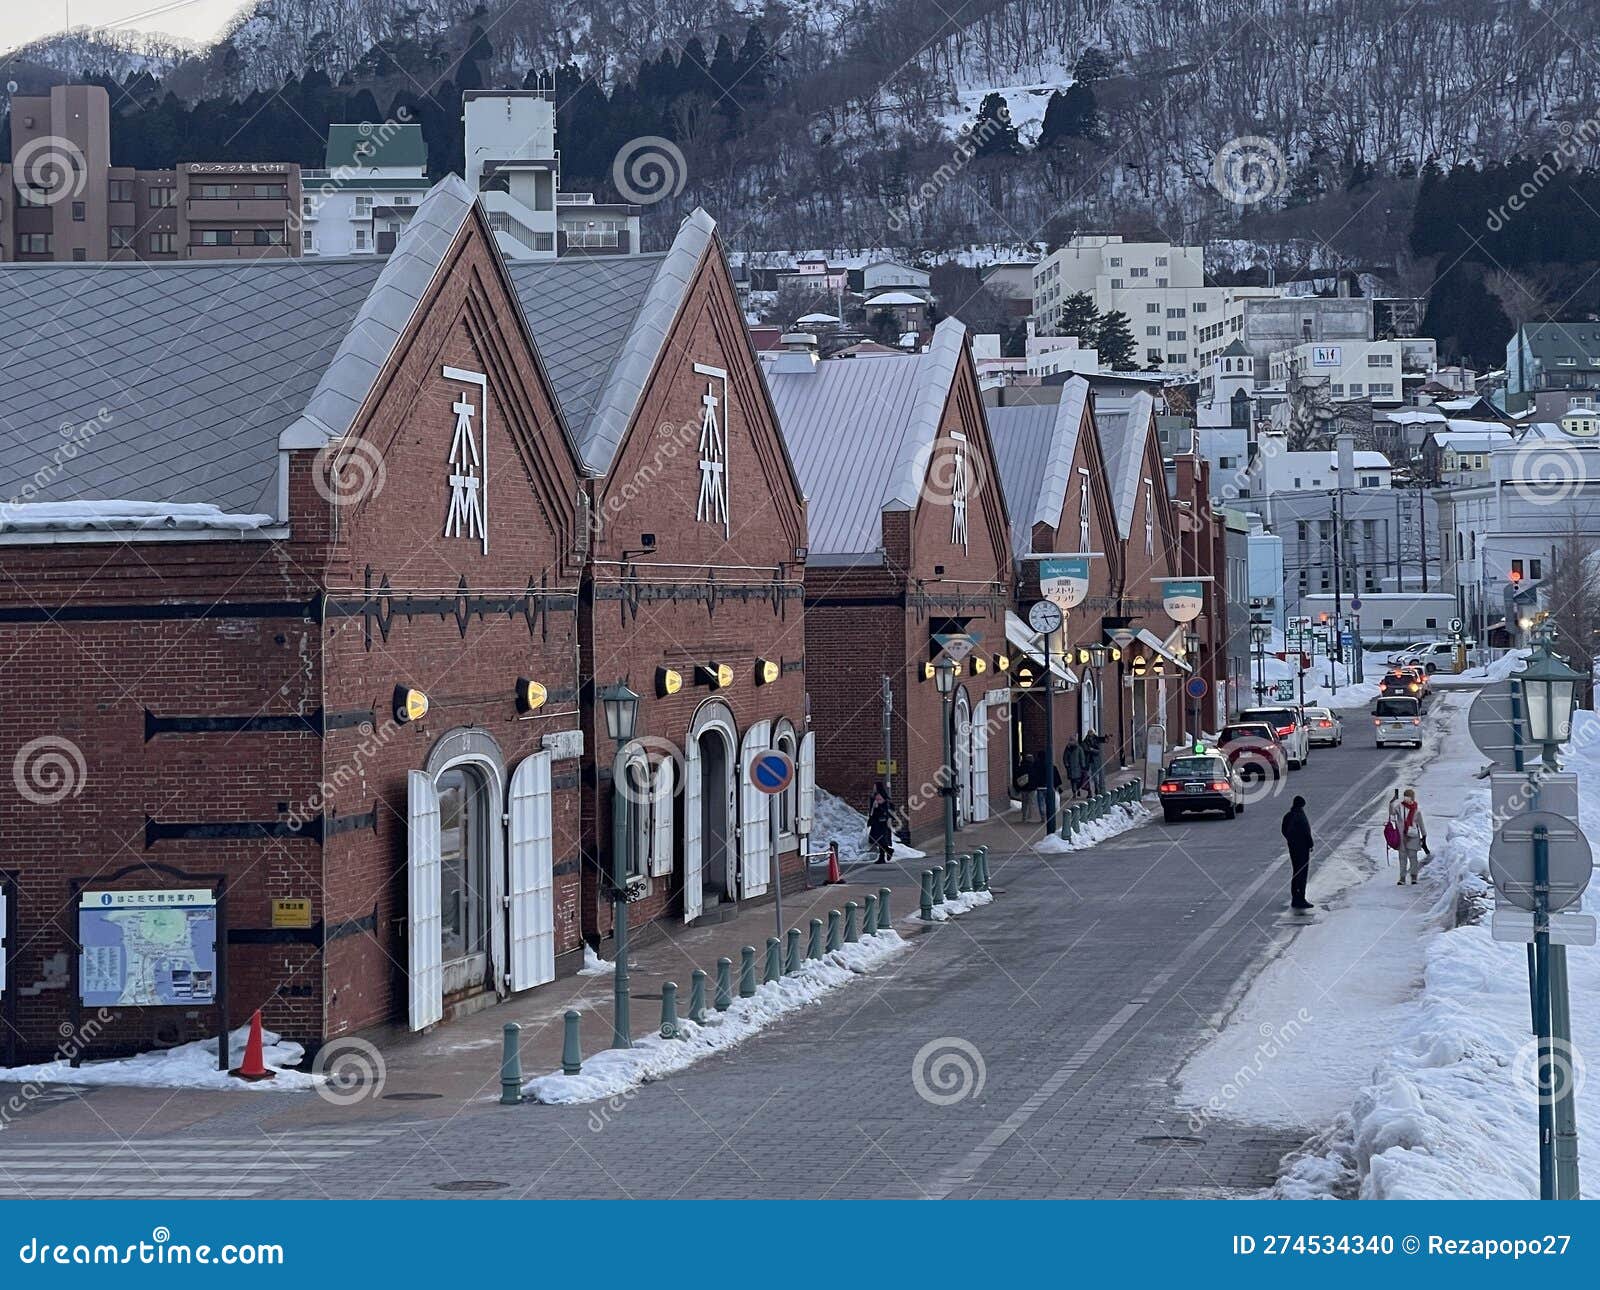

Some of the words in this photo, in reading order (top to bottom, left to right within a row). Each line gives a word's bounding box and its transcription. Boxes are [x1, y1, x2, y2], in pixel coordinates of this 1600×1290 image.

[1319, 349, 1335, 360] hif
[117, 894, 195, 903] はこだて観光案内
